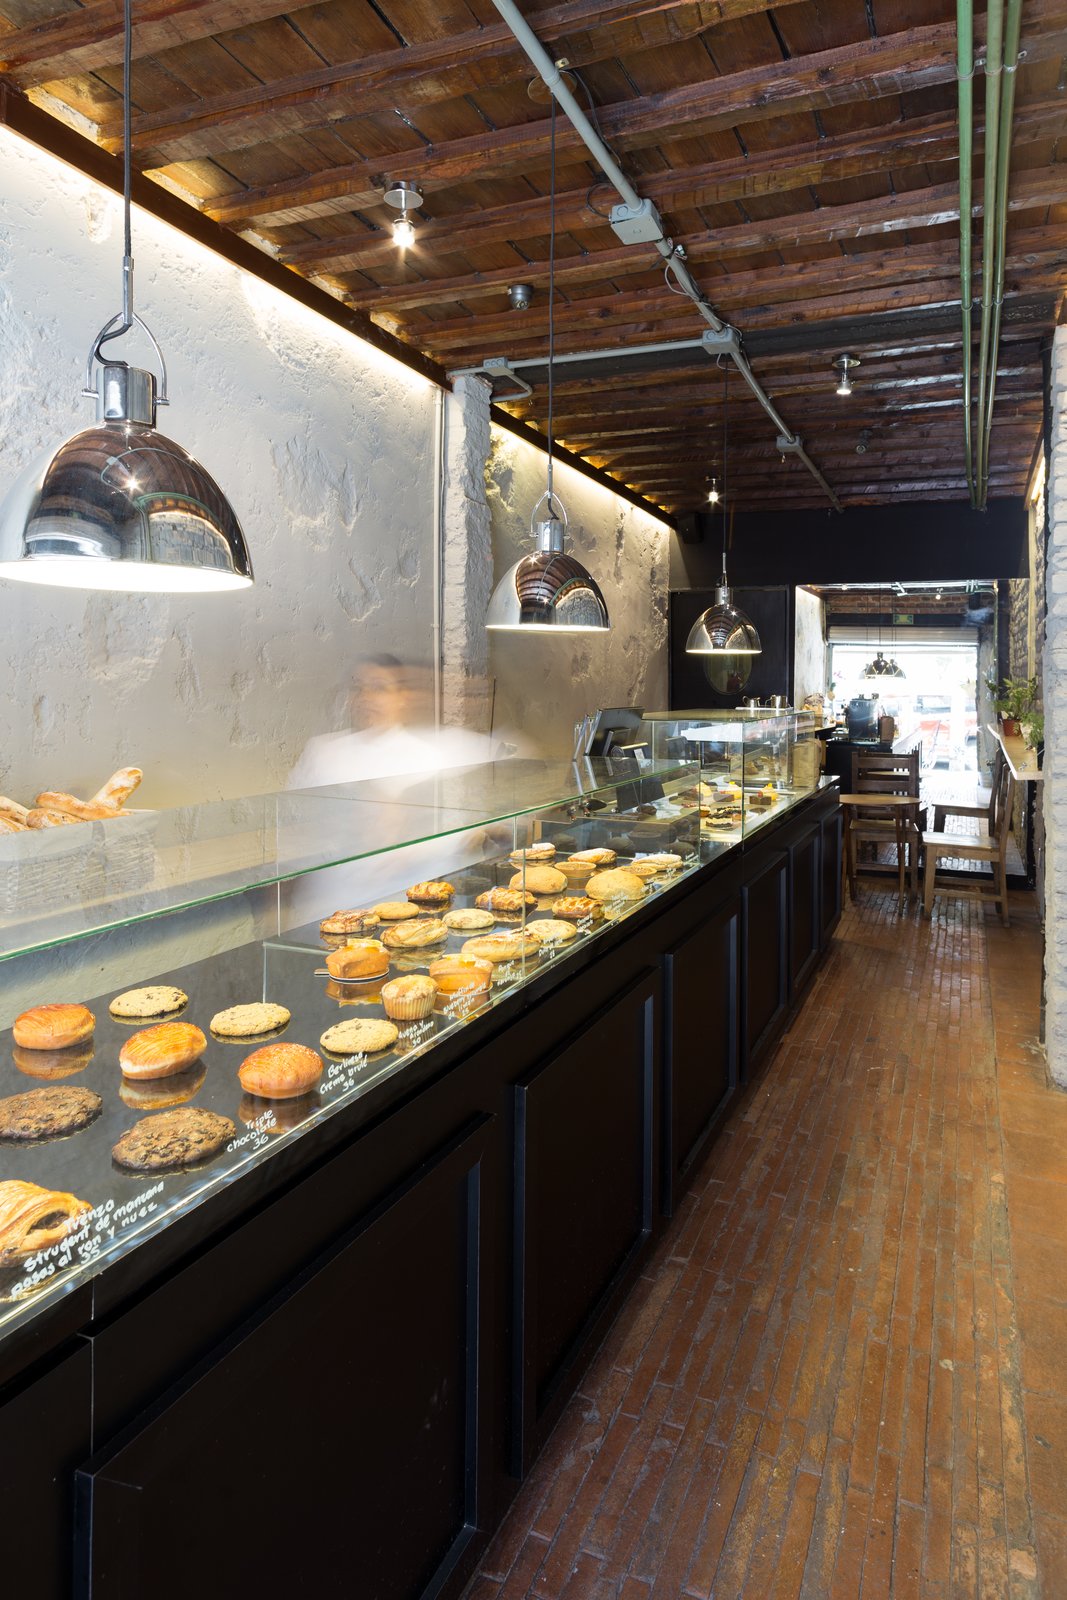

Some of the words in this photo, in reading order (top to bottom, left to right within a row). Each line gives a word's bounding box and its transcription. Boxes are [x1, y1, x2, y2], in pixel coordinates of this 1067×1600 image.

[342, 1078, 355, 1093] 36
[244, 1108, 274, 1131] Triple
[226, 1116, 277, 1154] chocolate
[252, 1133, 270, 1151] 36
[95, 1214, 111, 1233] de
[112, 1180, 165, 1222] manzana
[10, 1263, 56, 1301] pasas
[58, 1245, 73, 1268] al
[77, 1234, 102, 1256] ron
[121, 1201, 158, 1228] nuez
[80, 1243, 101, 1265] 35
